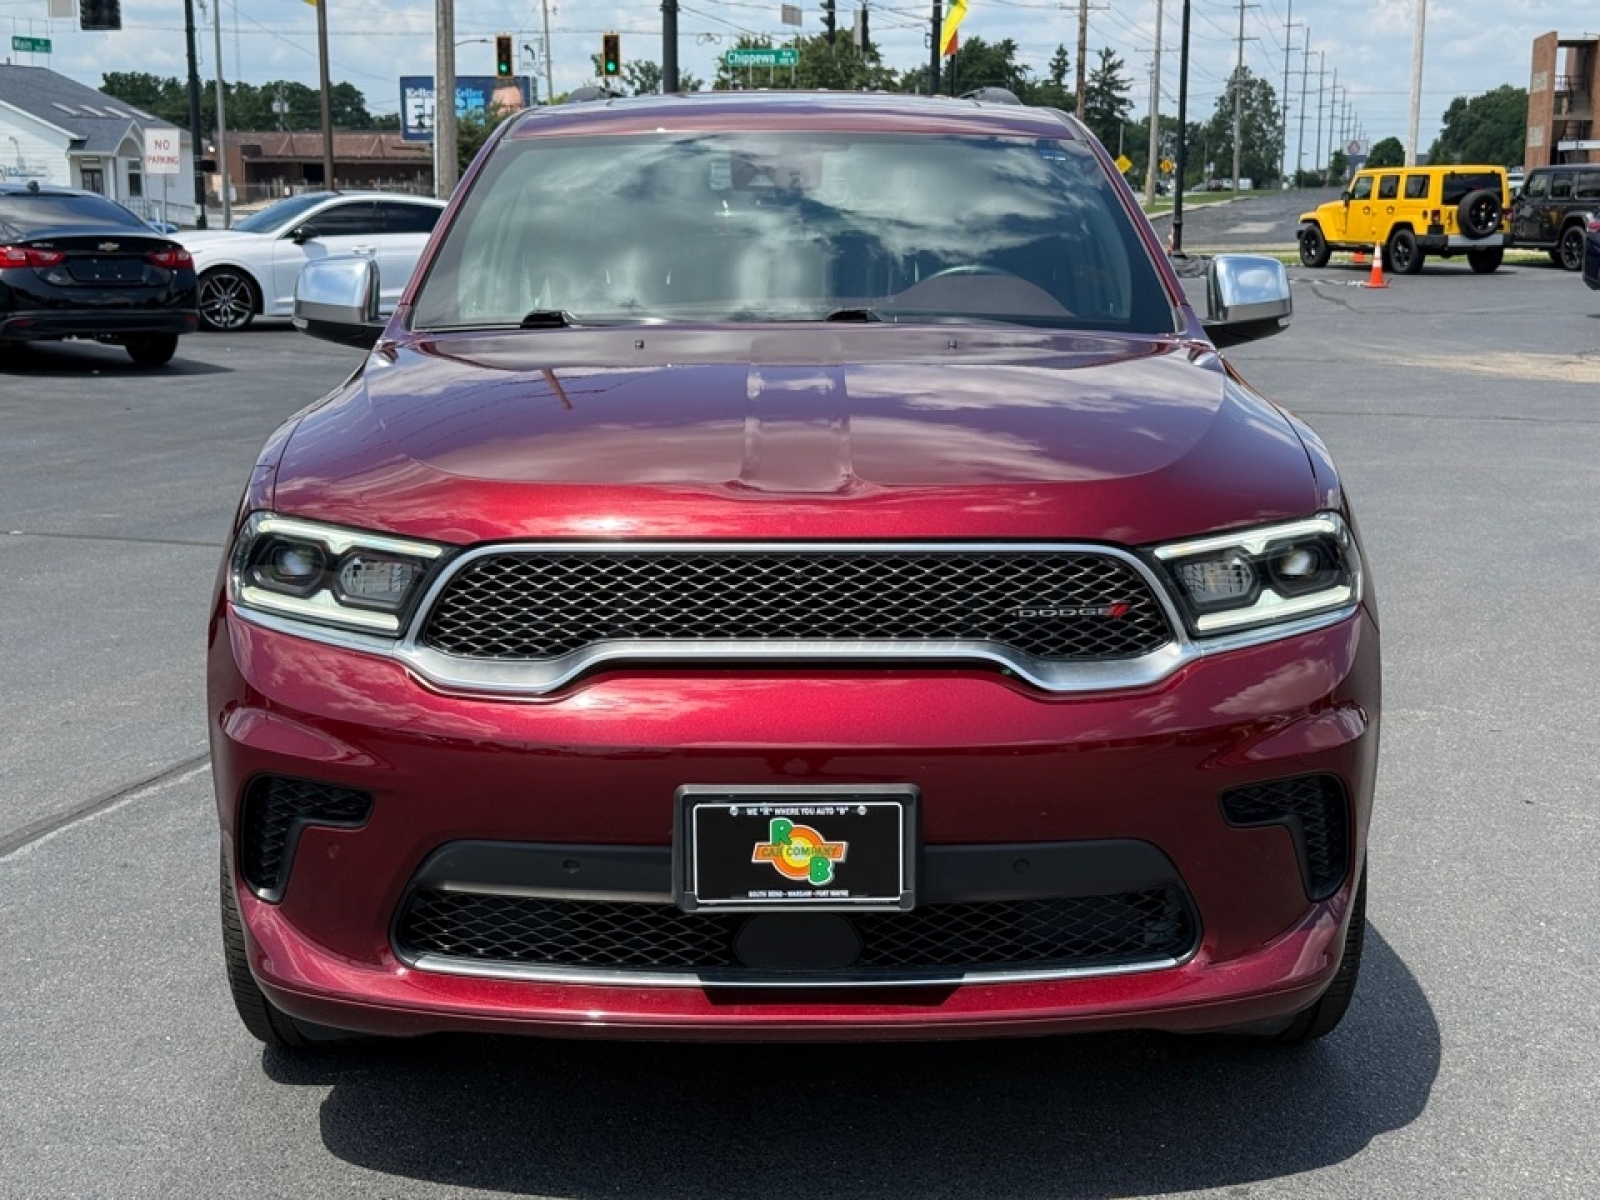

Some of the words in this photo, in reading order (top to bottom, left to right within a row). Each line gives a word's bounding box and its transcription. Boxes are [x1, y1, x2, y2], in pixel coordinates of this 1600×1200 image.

[728, 52, 775, 65] Chippewa
[405, 87, 437, 98] Kelle
[154, 139, 171, 150] NO
[147, 154, 180, 165] PARKING
[1018, 608, 1110, 618] DODGE
[746, 807, 759, 816] WE
[774, 807, 800, 816] WHERE
[801, 807, 815, 816] YOU
[816, 807, 835, 816] AUTO
[770, 818, 793, 845] R
[761, 845, 784, 858] CAR
[786, 845, 838, 858] COMPANY
[809, 856, 832, 884] B
[748, 890, 767, 898] SOUTH
[768, 890, 783, 898] BEND
